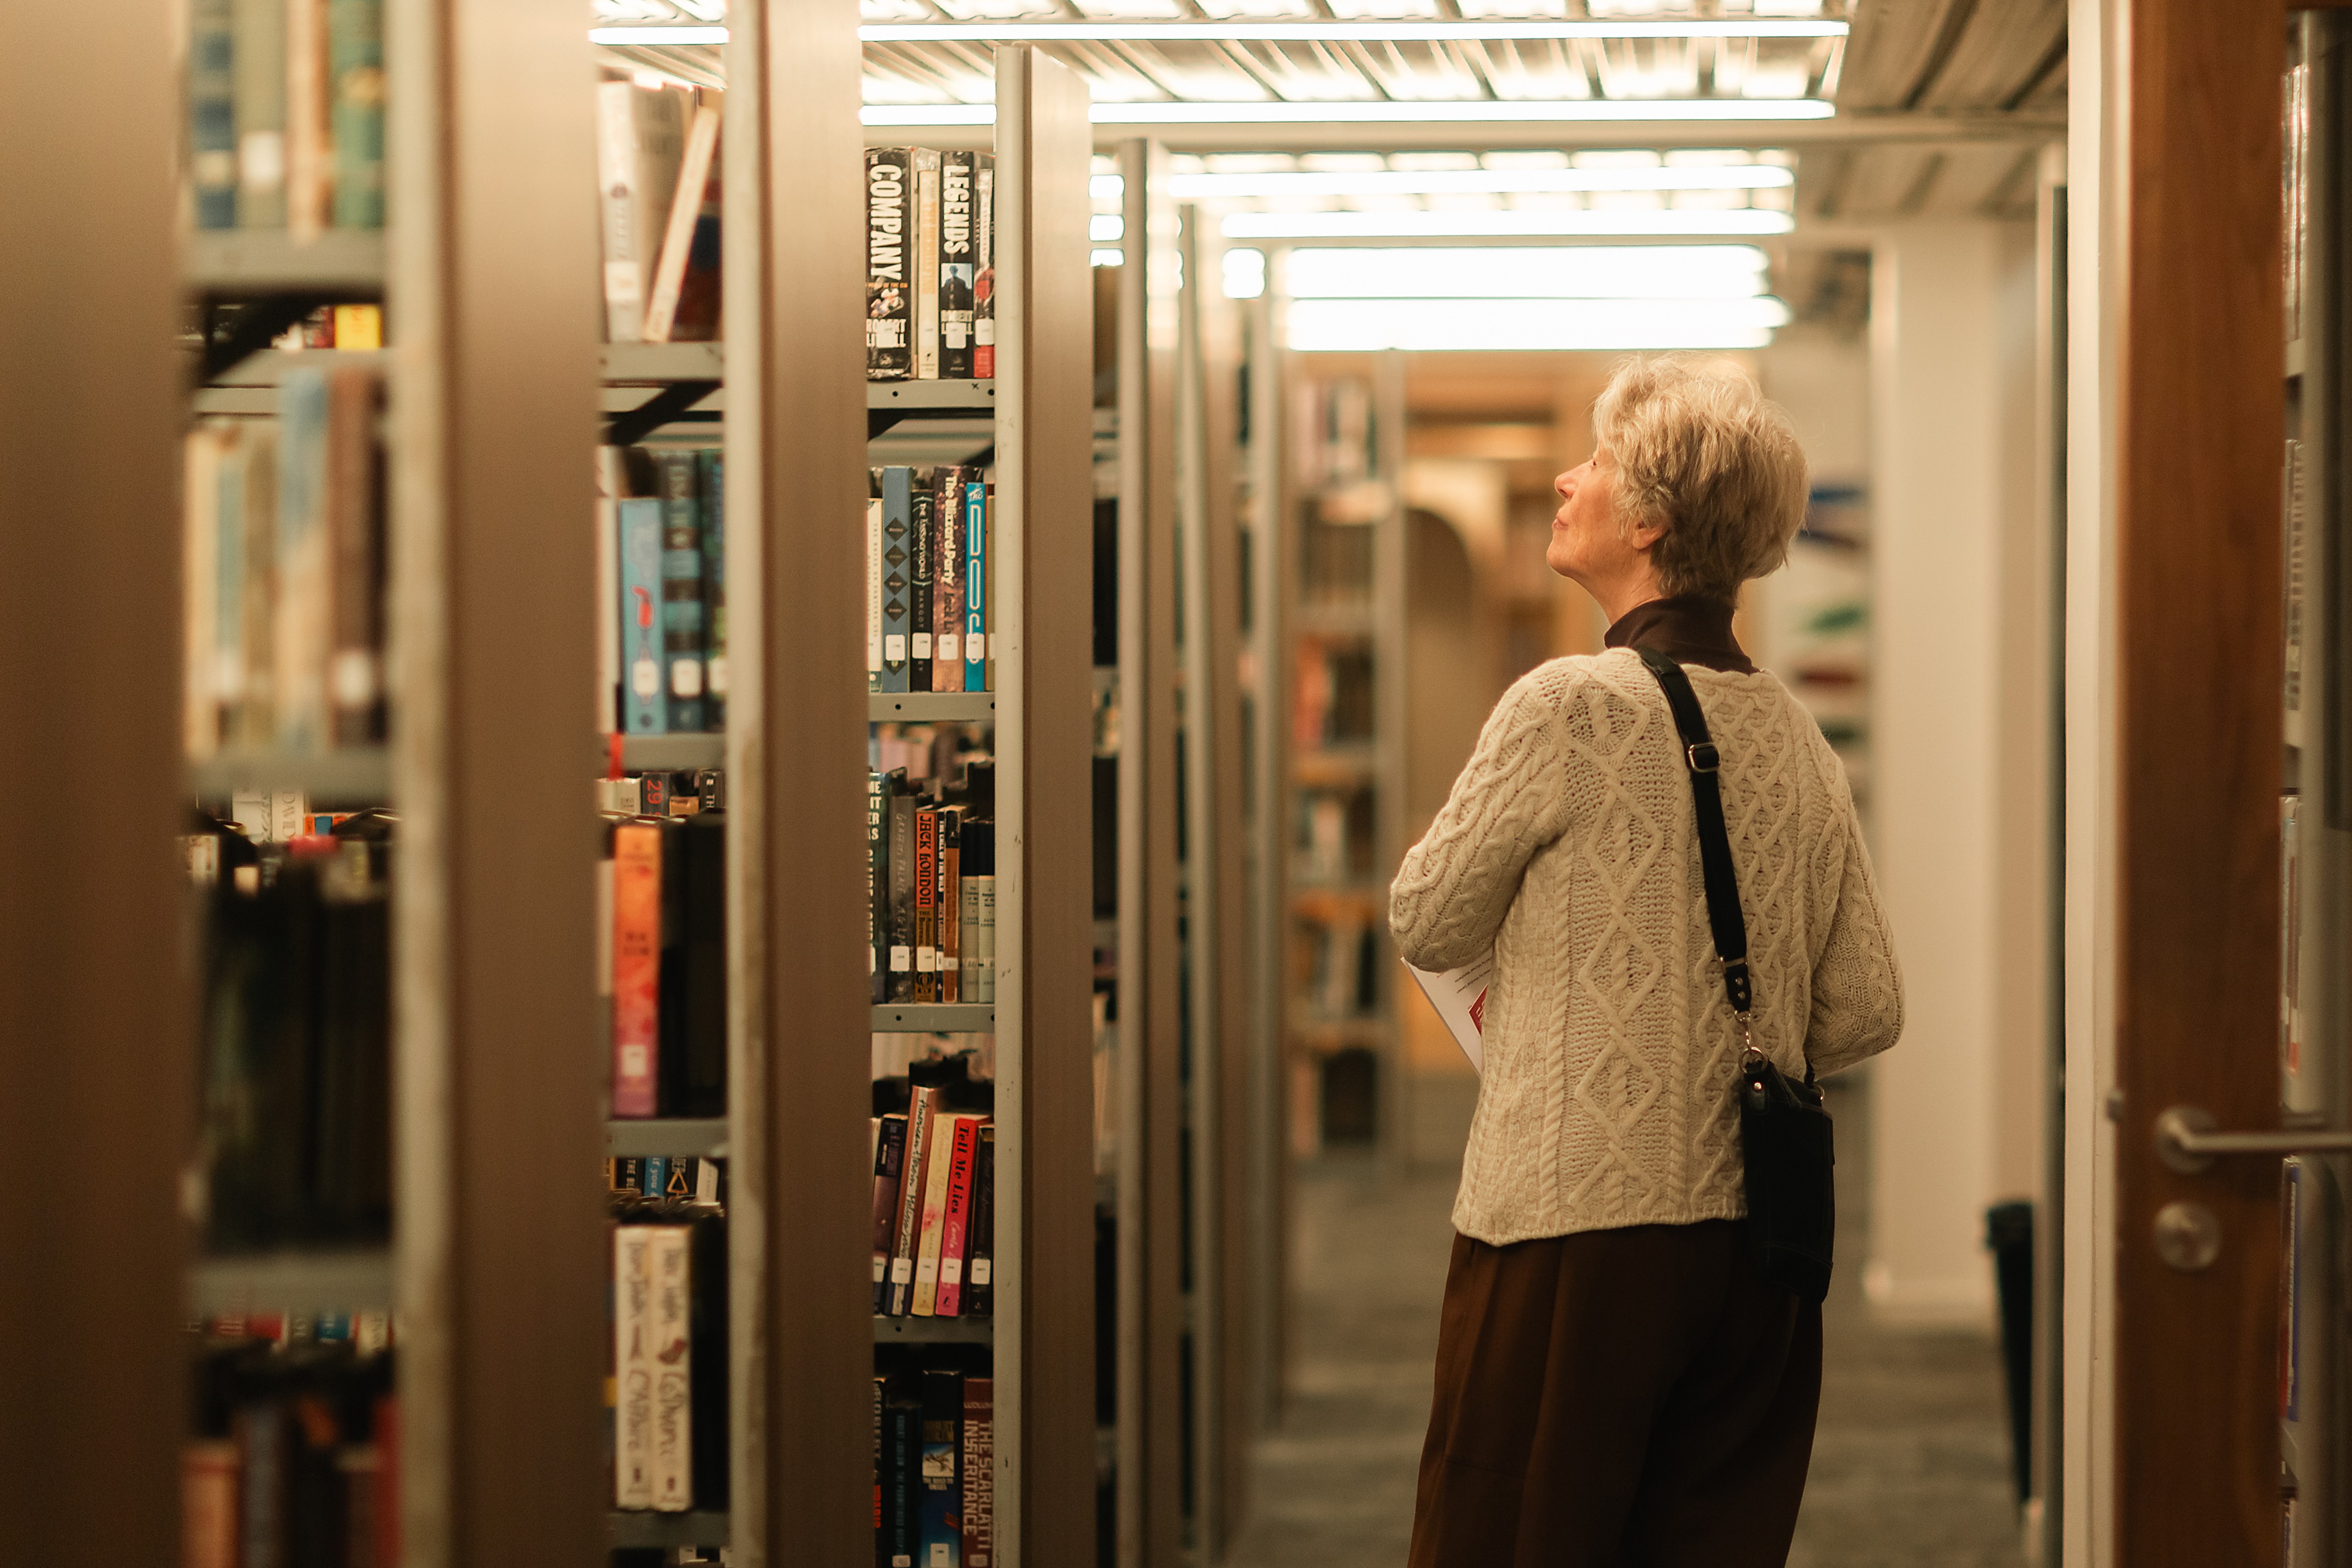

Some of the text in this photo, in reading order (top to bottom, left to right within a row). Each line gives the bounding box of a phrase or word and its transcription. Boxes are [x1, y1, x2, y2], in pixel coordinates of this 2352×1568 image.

[870, 165, 902, 280] COMPANY
[943, 165, 970, 254] LEGENDS
[866, 318, 906, 333] RORT
[945, 476, 957, 498] The
[944, 499, 957, 549] Blizzard
[940, 550, 956, 586] Party
[647, 779, 662, 804] 29
[920, 815, 931, 849] JACK
[920, 853, 931, 905] LONDON
[956, 1126, 970, 1152] Tell
[954, 1157, 966, 1179] Me
[951, 1184, 964, 1214] Lies
[978, 1421, 992, 1549] THE SCARLATTI
